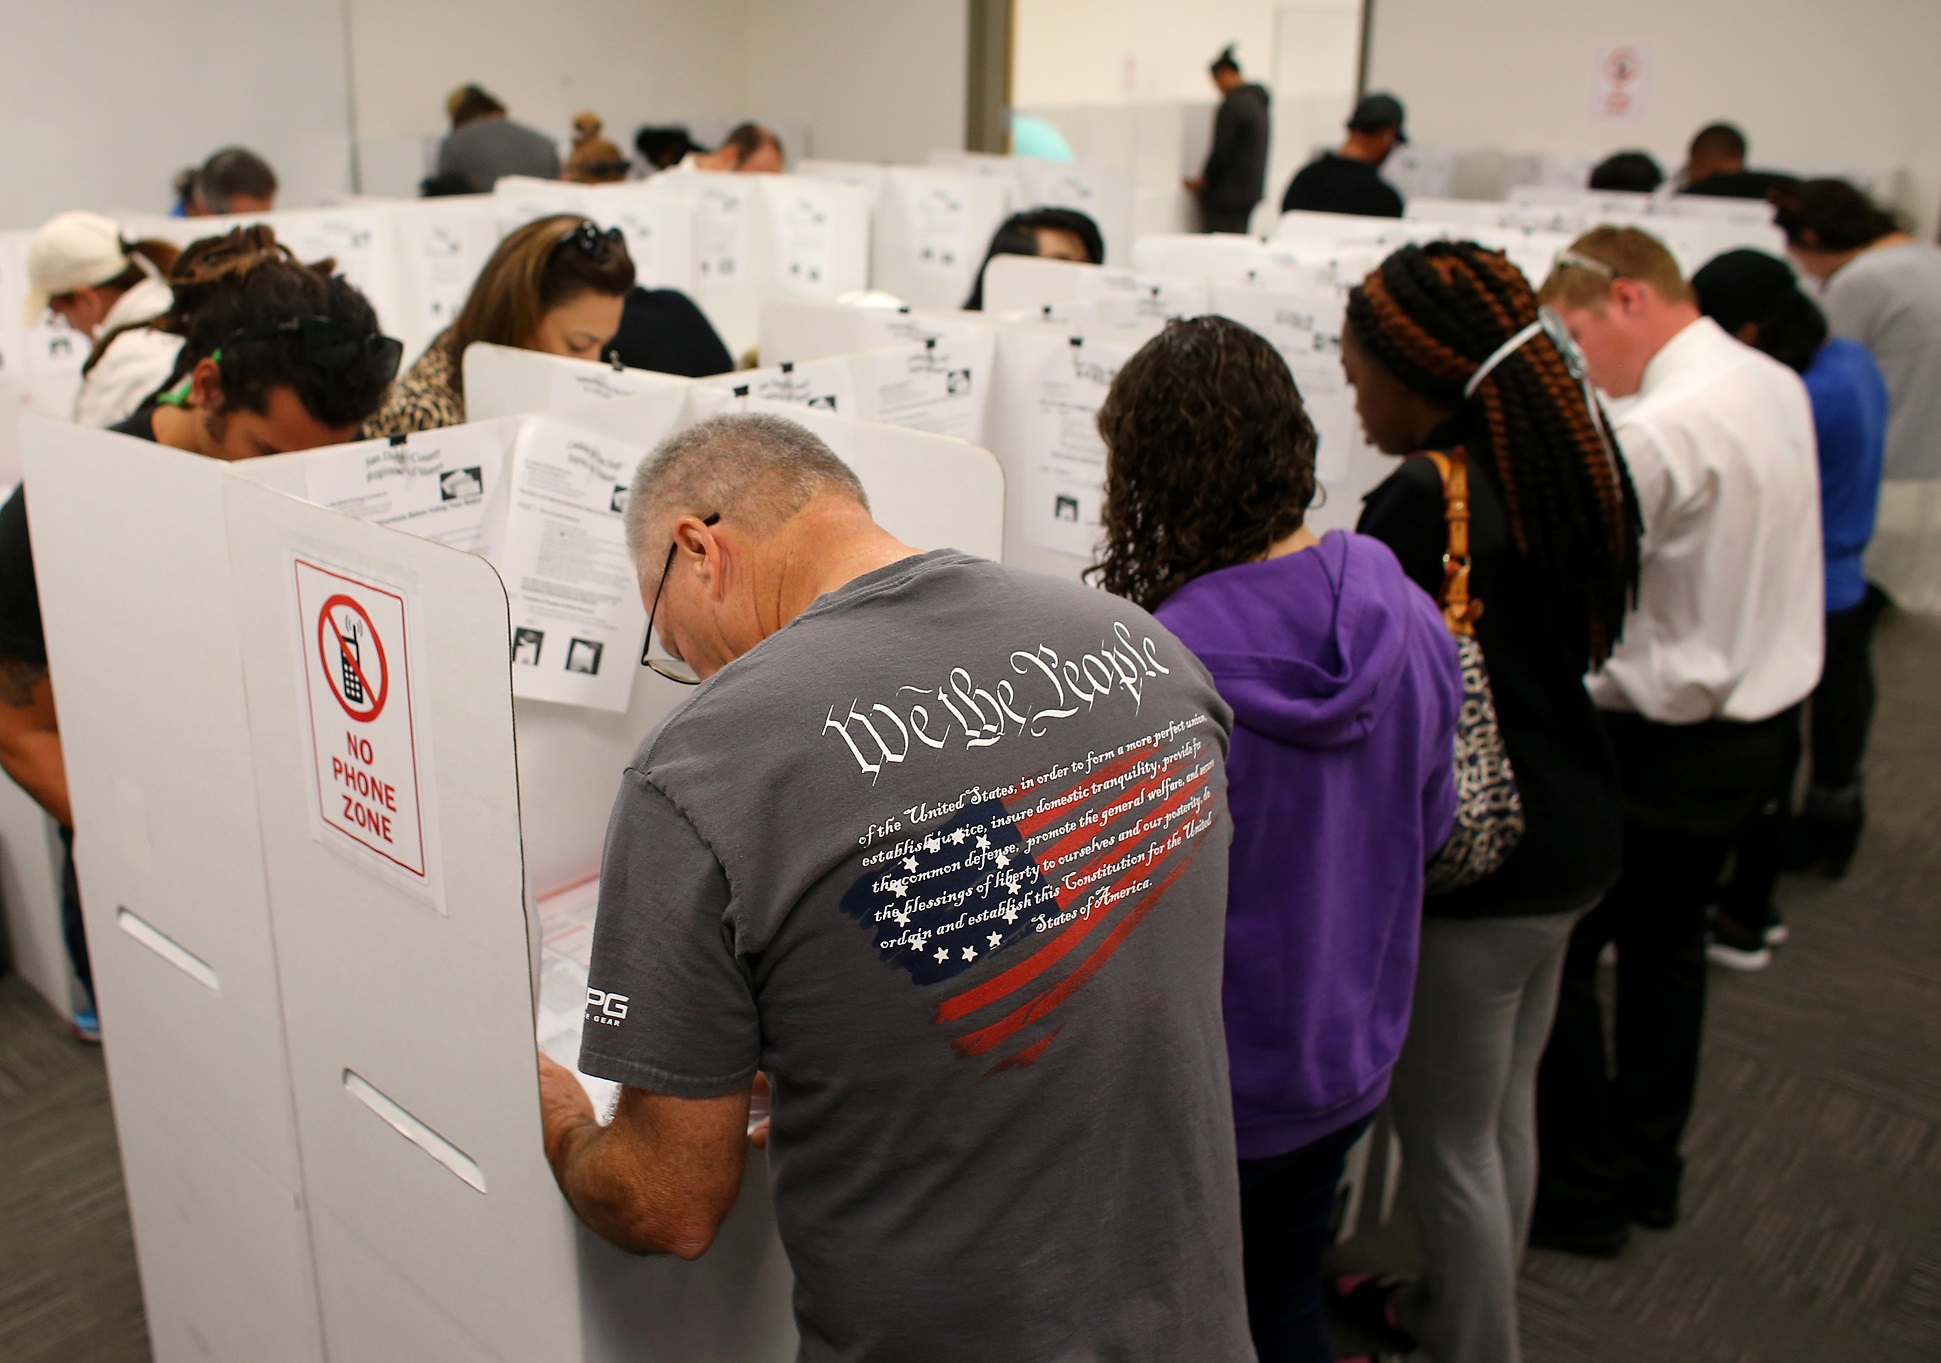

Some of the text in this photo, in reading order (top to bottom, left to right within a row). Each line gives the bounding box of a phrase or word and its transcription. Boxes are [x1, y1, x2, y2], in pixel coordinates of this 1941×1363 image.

[347, 730, 374, 765] NO
[822, 621, 1169, 786] We the People
[332, 755, 397, 813] PHONE
[342, 793, 393, 844] ZONE
[858, 824, 877, 849] of
[877, 816, 902, 837] the
[903, 793, 966, 824] United
[965, 785, 1018, 806] States,
[1020, 776, 1034, 790] in
[1036, 764, 1069, 784] order
[1071, 761, 1084, 773] to
[1085, 750, 1116, 774] form
[1117, 745, 1124, 755] a
[1125, 735, 1152, 752] more
[1153, 720, 1185, 748] perfect
[901, 860, 961, 885] common
[1024, 822, 1077, 854] promote
[1079, 808, 1099, 828] the
[1099, 788, 1145, 827] general
[1147, 777, 1185, 801] welfare,
[932, 823, 987, 853] jutice,
[991, 808, 1033, 829] insure
[1036, 786, 1090, 814] domestic
[1091, 761, 1161, 795] tranquility,
[1162, 741, 1193, 772] provide
[875, 903, 900, 922] the
[904, 886, 974, 915] blessings
[976, 873, 994, 899] of
[994, 864, 1040, 888] liberty
[1042, 859, 1056, 872] to
[1058, 836, 1116, 865] ourselves
[1118, 819, 1142, 842] and
[1143, 817, 1163, 832] our
[1163, 796, 1203, 829] posterity,
[880, 927, 932, 949] ordain
[936, 913, 967, 935] and
[1034, 884, 1060, 905] this
[1061, 851, 1145, 890] Constitution
[1145, 841, 1165, 866] for
[1167, 831, 1182, 850] the
[1031, 879, 1153, 933] States of America.
[593, 1015, 621, 1027] GEAR
